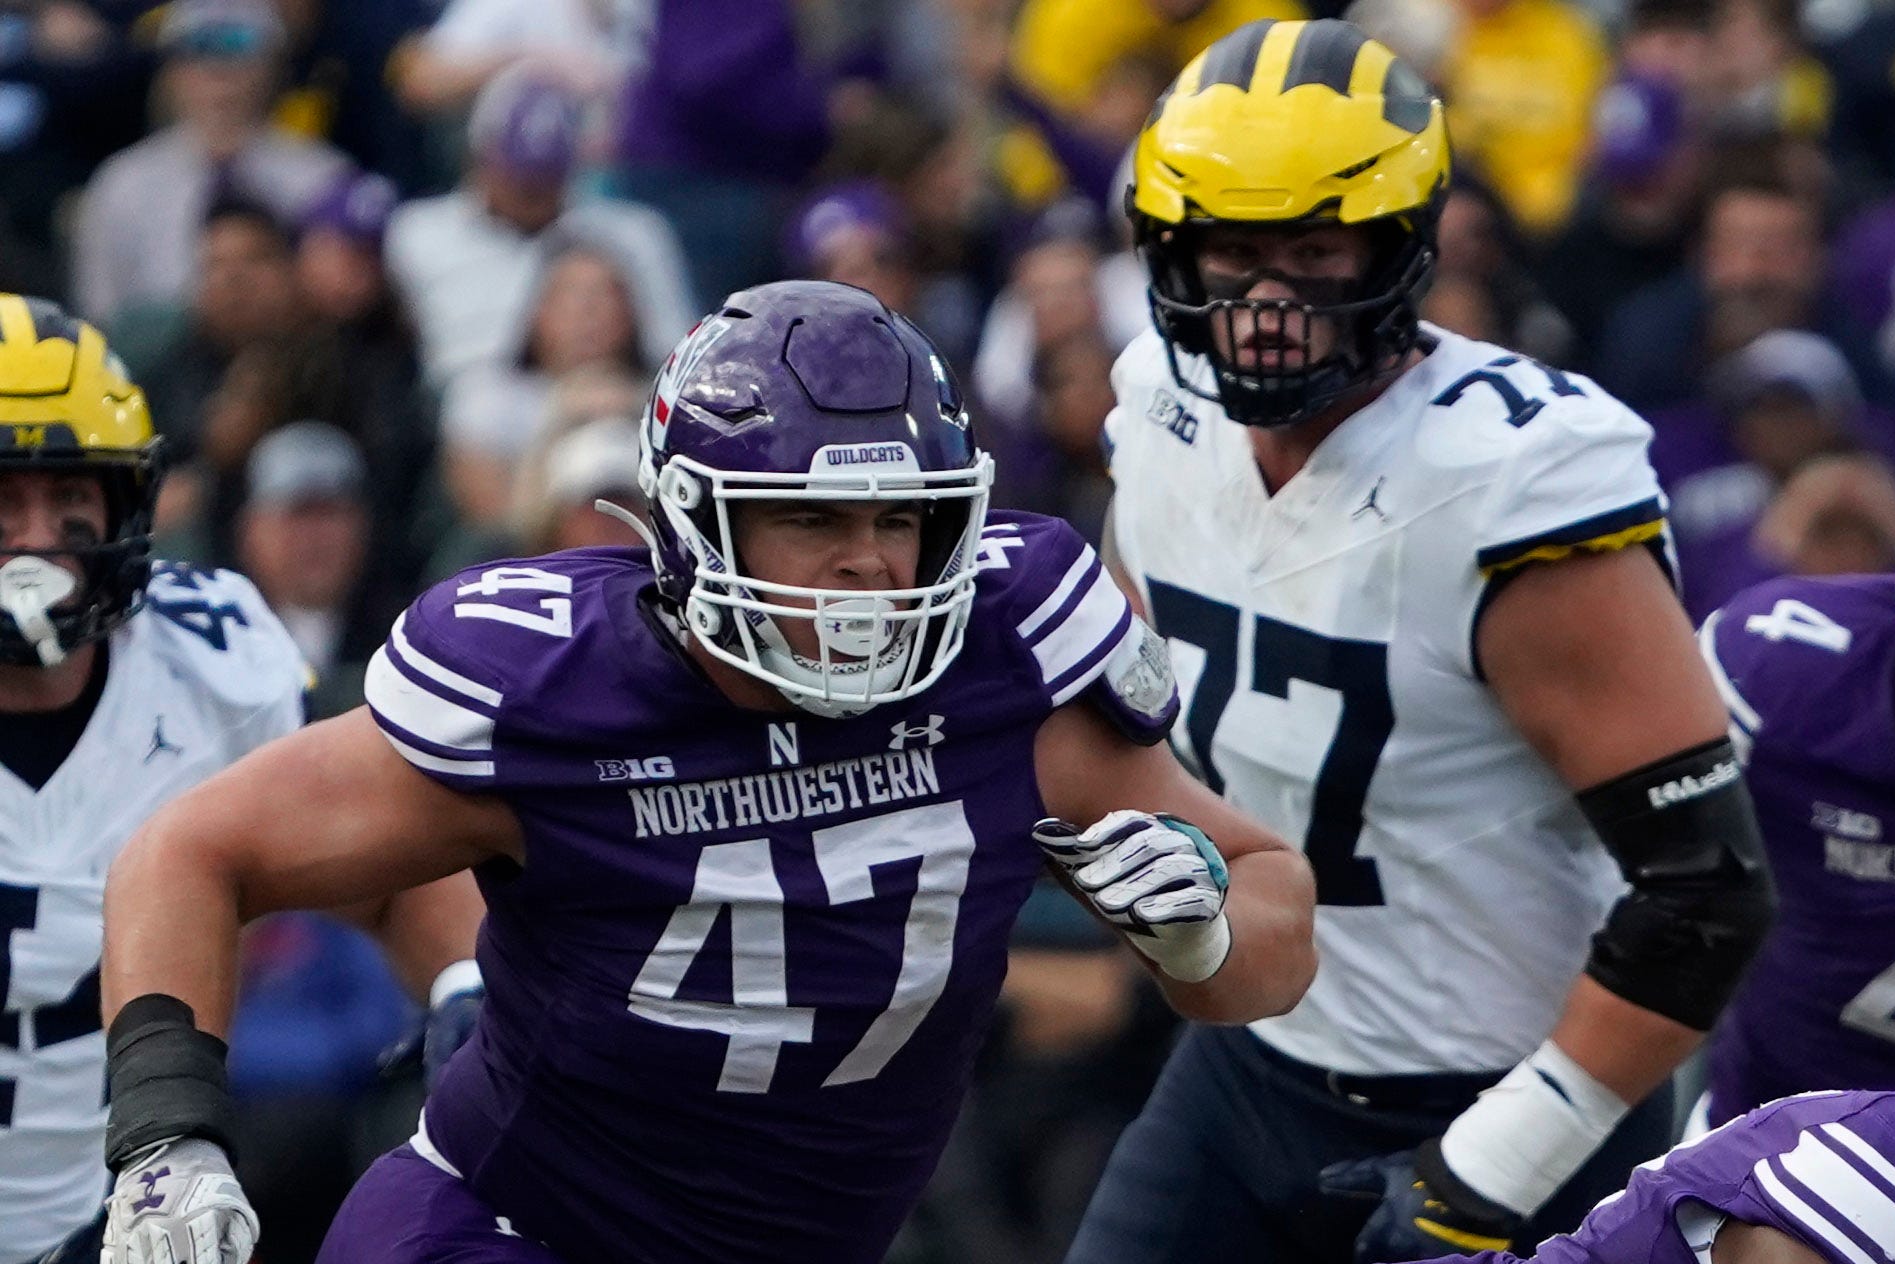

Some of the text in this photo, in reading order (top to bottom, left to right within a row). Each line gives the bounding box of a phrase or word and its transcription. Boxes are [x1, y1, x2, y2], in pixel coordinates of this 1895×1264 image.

[826, 444, 905, 467] WILDCATS
[976, 523, 1026, 569] 4
[456, 566, 574, 638] 47
[1746, 598, 1852, 653] 4
[768, 722, 799, 766] N
[1144, 572, 1394, 907] 77
[627, 746, 941, 839] NORTHWESTERN
[627, 799, 977, 1095] 47
